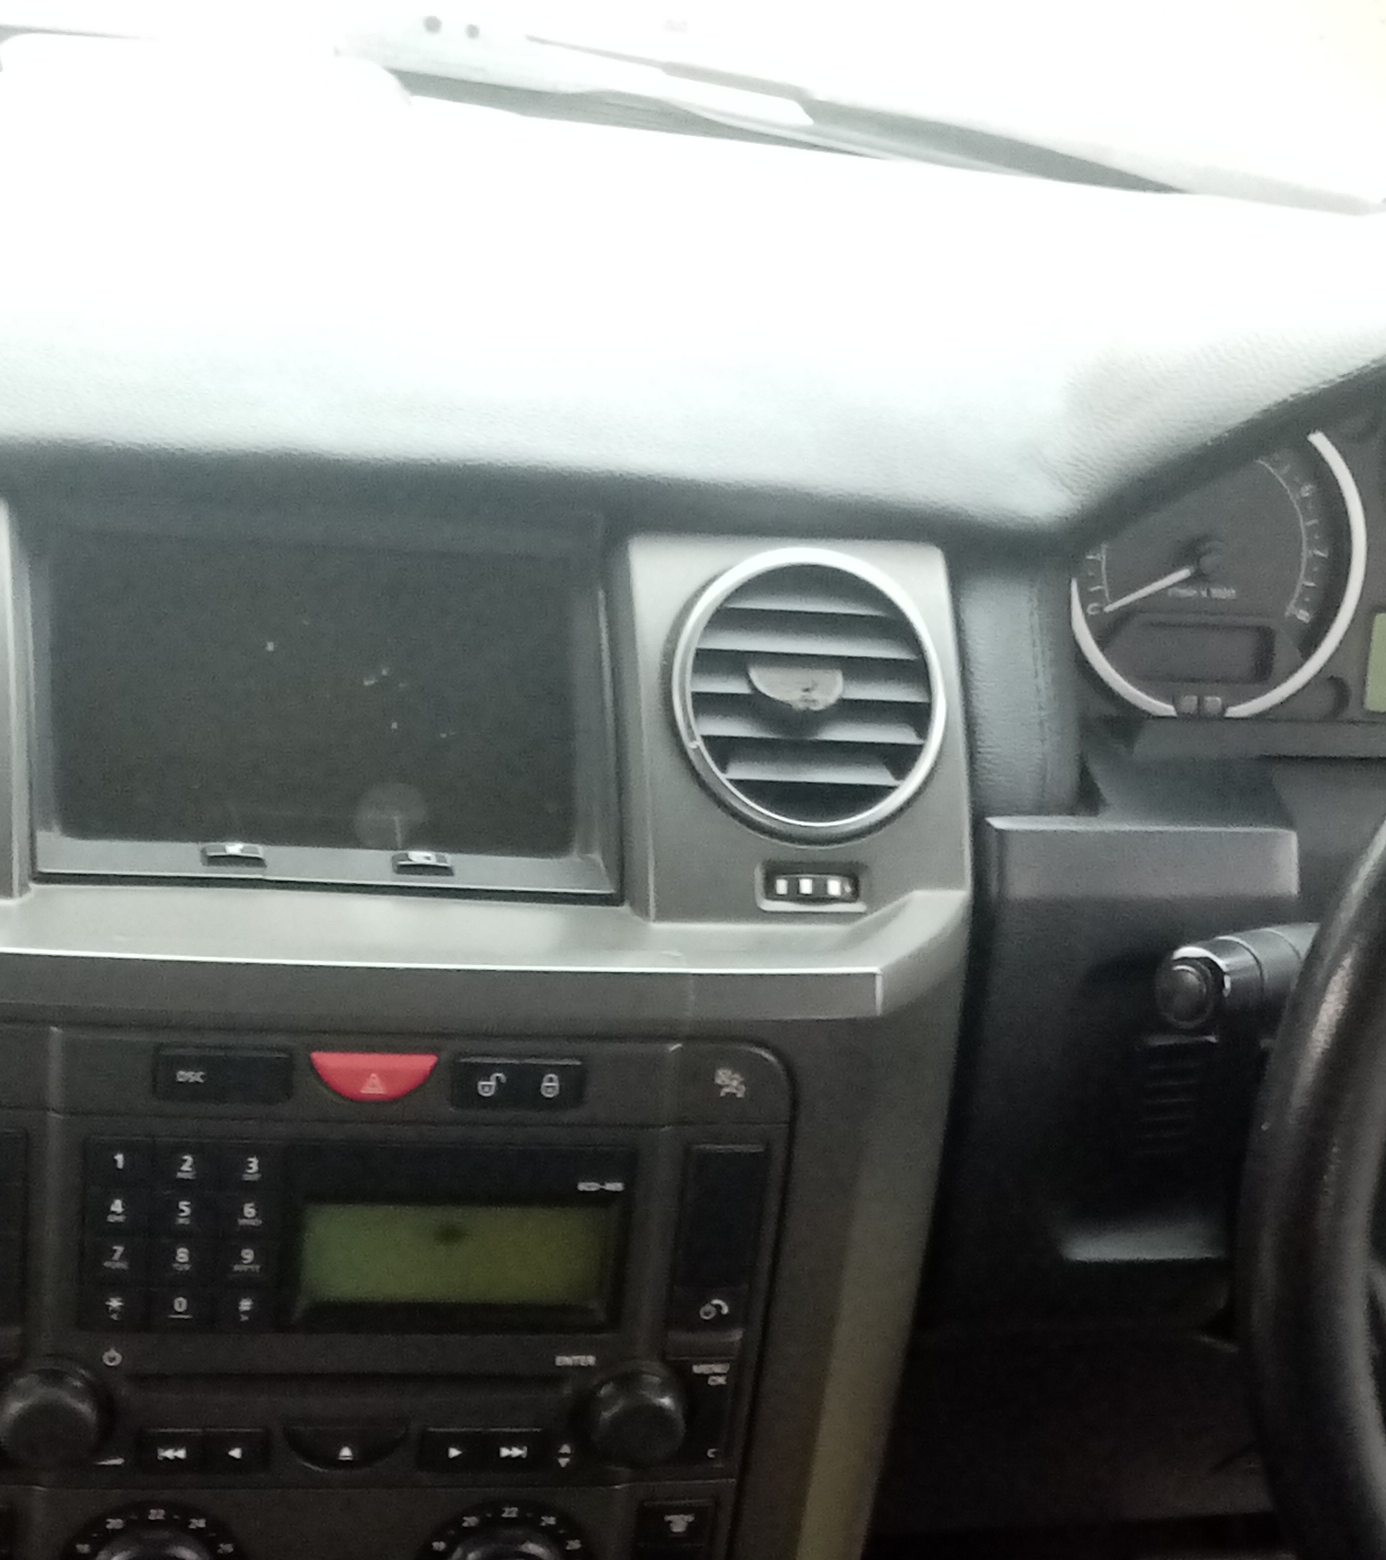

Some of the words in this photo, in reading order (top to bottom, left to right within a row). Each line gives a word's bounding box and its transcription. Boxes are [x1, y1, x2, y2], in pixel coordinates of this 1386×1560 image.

[113, 1153, 125, 1170] 1
[180, 1155, 194, 1172] 2
[245, 1156, 259, 1173] 3
[109, 1199, 125, 1214] 4
[178, 1201, 191, 1217] 5
[242, 1202, 257, 1218] 6
[112, 1245, 125, 1261] 7
[175, 1247, 189, 1263] 8
[240, 1248, 255, 1264] 9
[173, 1297, 188, 1312] 0
